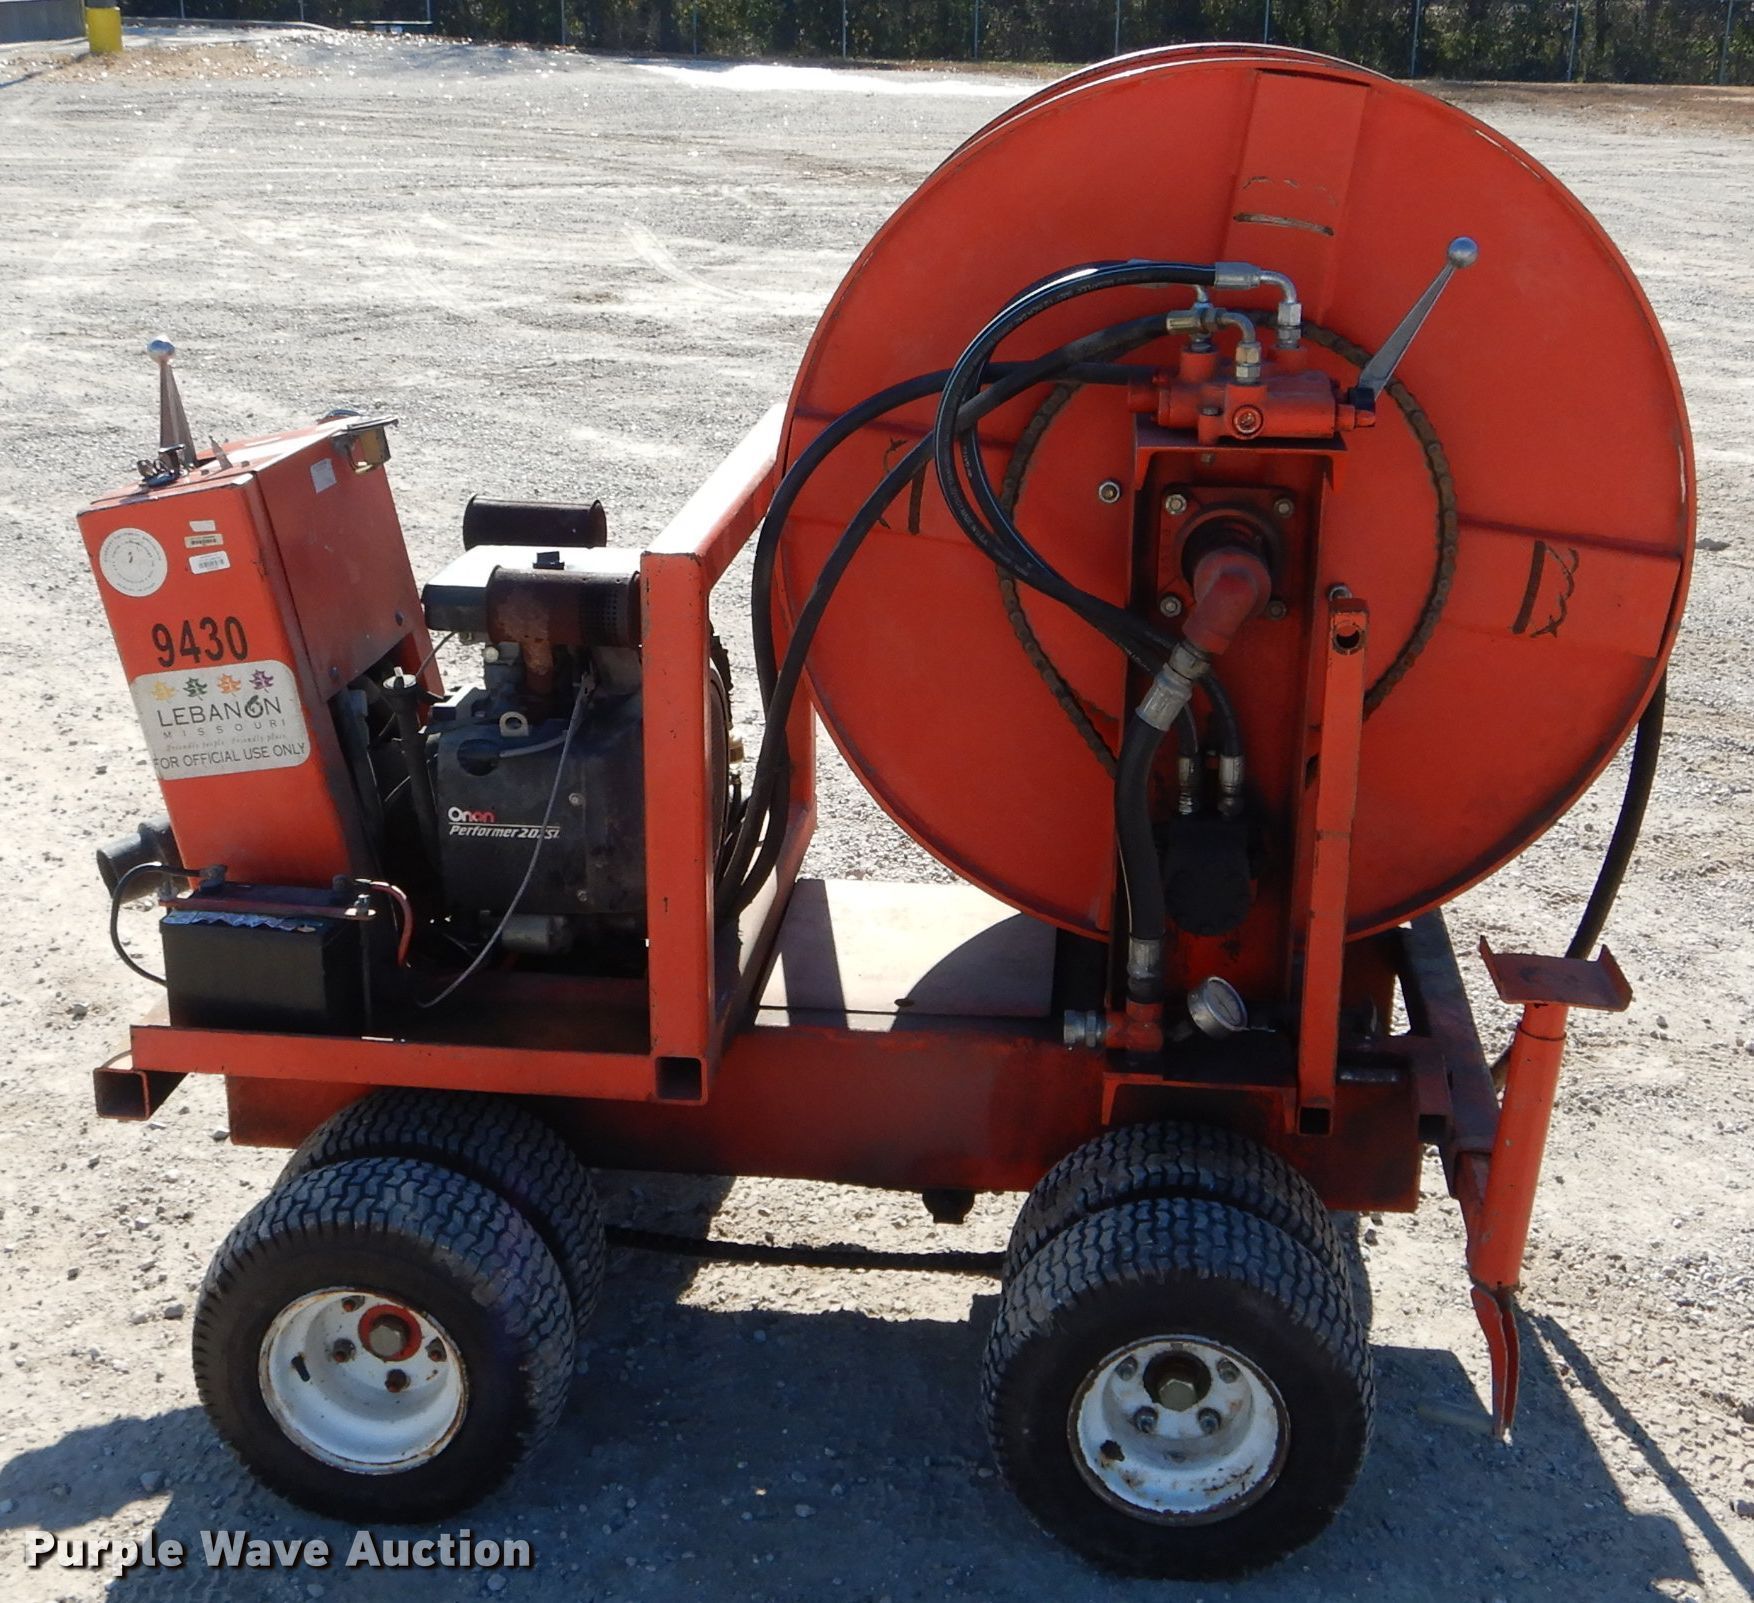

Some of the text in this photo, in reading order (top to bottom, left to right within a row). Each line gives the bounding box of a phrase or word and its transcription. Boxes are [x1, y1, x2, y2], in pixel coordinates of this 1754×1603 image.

[151, 616, 249, 667] 9430
[156, 694, 282, 727] LEBANON
[163, 718, 286, 739] MISSOURI
[153, 742, 306, 770] FOR OFFICIAL USE ONLY
[447, 806, 496, 823] Onan
[449, 825, 517, 838] Performer
